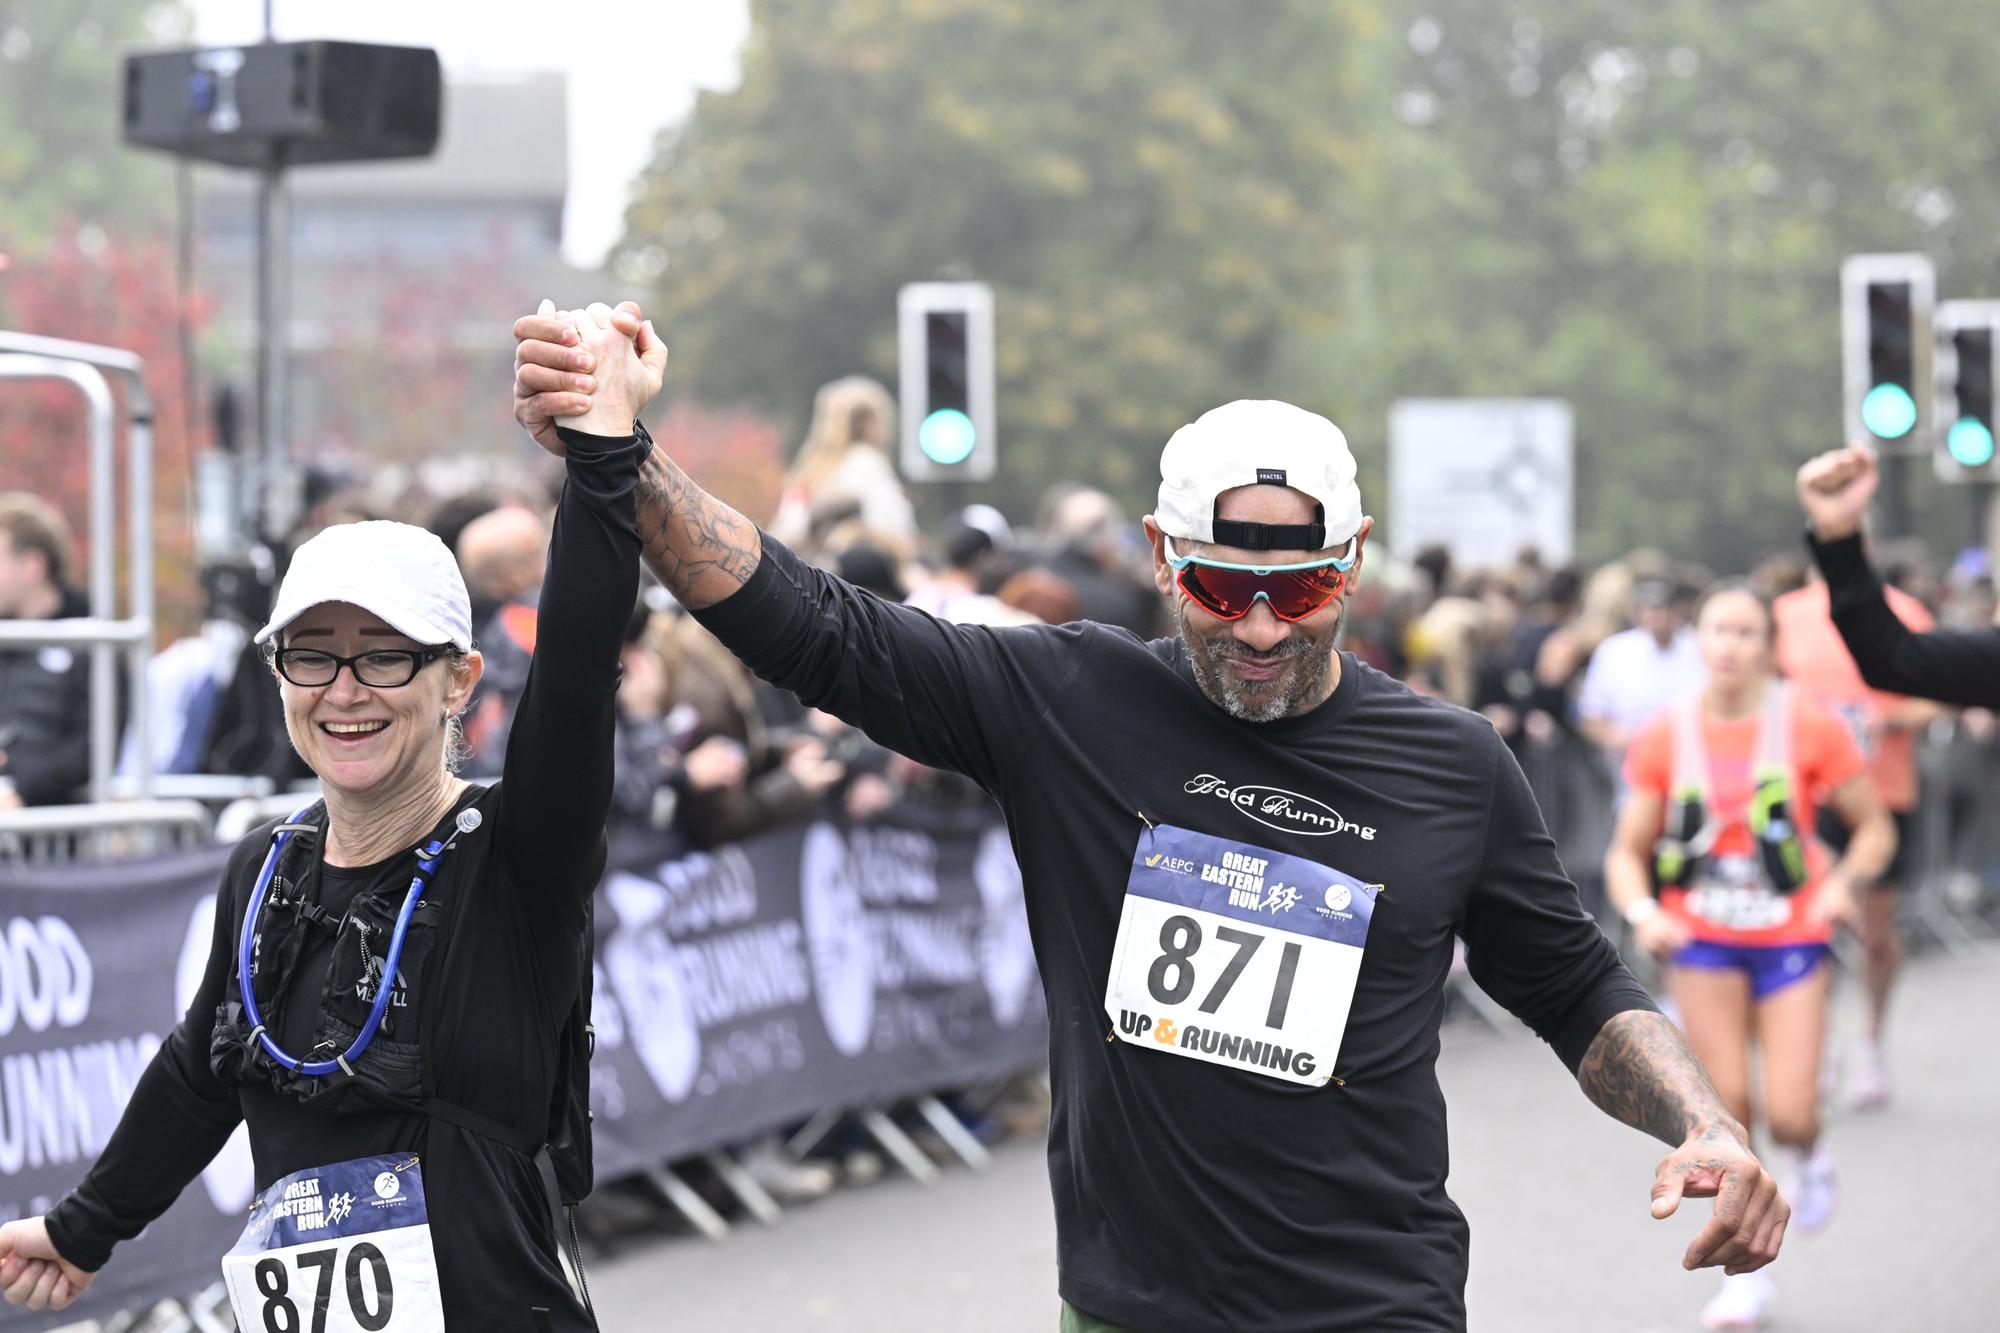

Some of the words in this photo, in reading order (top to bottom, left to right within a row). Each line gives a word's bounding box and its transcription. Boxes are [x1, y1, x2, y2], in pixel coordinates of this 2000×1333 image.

[1184, 774, 1256, 807] Acid
[1260, 795, 1377, 841] Running
[1161, 856, 1194, 873] AEPG
[1222, 851, 1268, 877] GREAT
[1201, 863, 1264, 894] EASTERN
[1228, 888, 1261, 912] RUN
[1147, 915, 1302, 1030] 871
[1119, 1008, 1152, 1037] UP
[1153, 1017, 1178, 1046] &
[1180, 1025, 1317, 1077] RUNNING
[273, 1195, 323, 1220] ASTERN
[297, 1212, 325, 1231] RUN
[255, 1242, 394, 1333] 870
